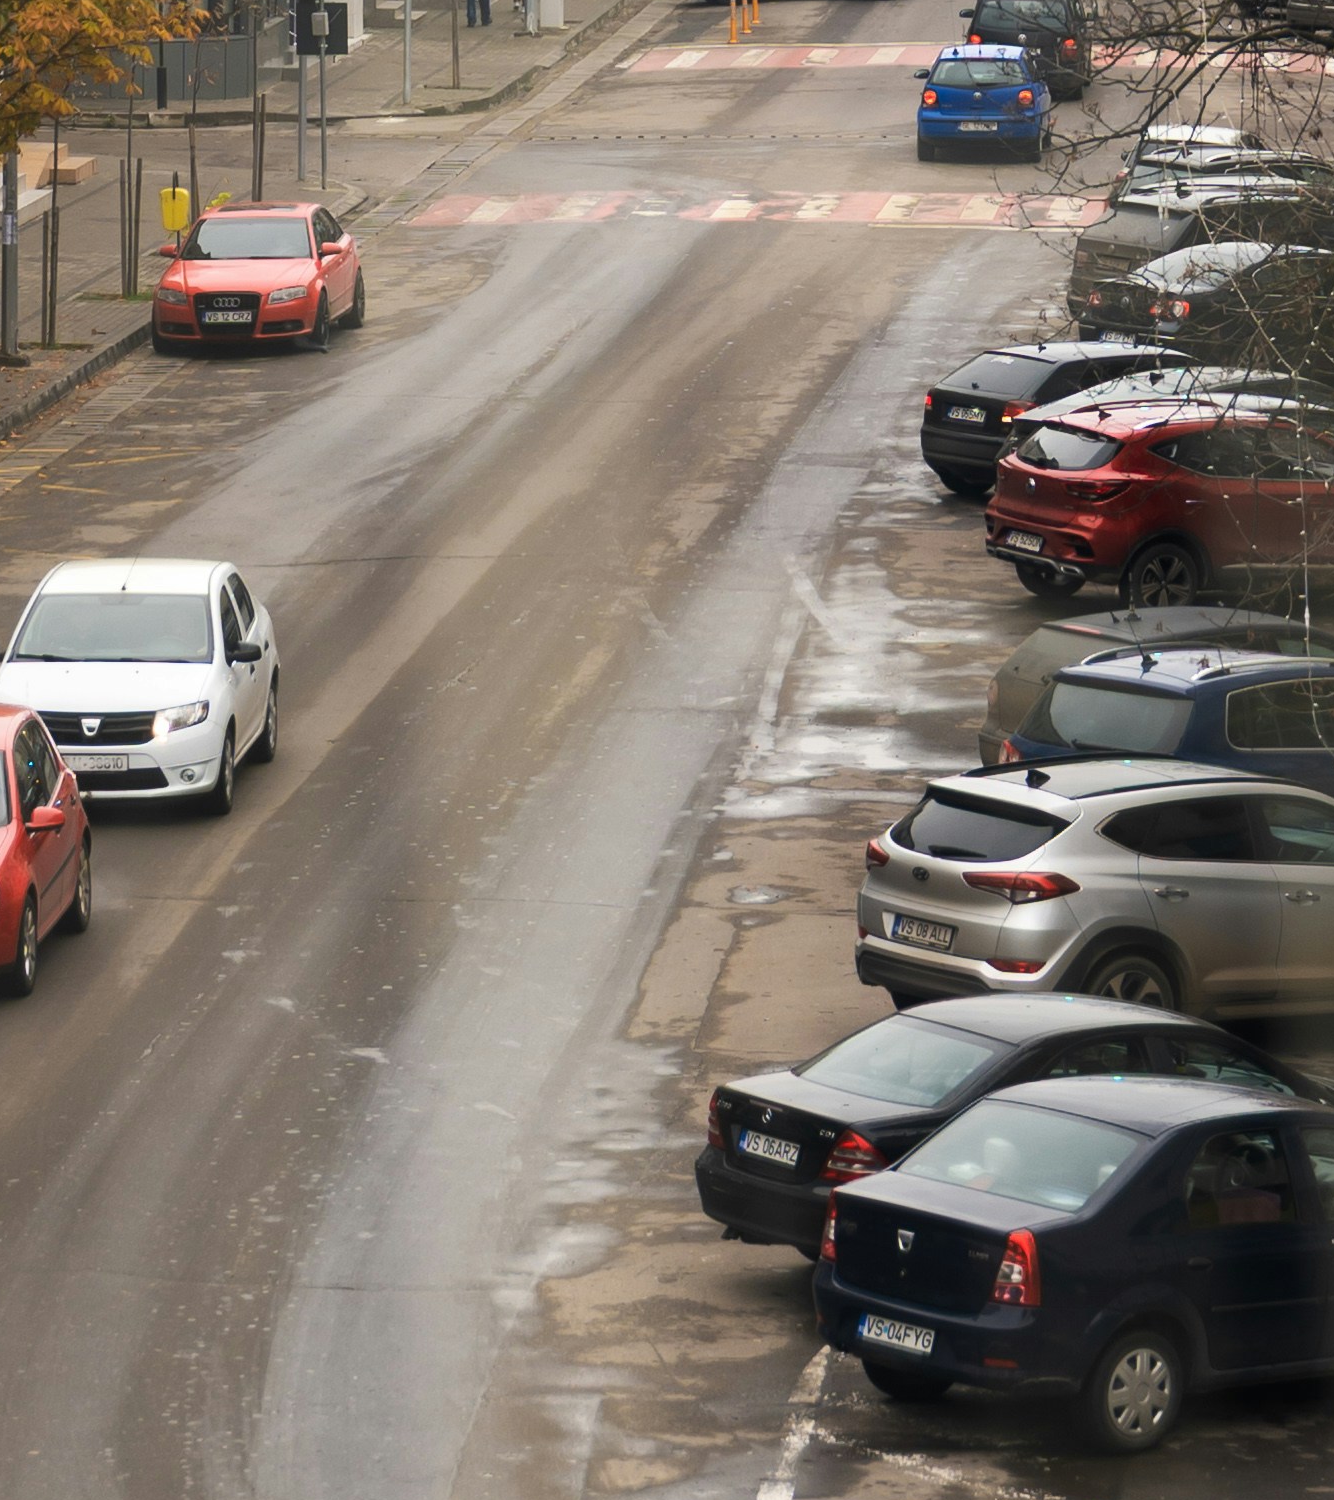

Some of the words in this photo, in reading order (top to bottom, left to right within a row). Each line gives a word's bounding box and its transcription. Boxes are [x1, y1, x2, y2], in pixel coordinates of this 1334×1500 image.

[900, 919, 914, 935] VS
[916, 922, 928, 938] 08
[929, 925, 948, 943] ALL
[746, 1132, 760, 1152] VS
[866, 1315, 884, 1337] VS
